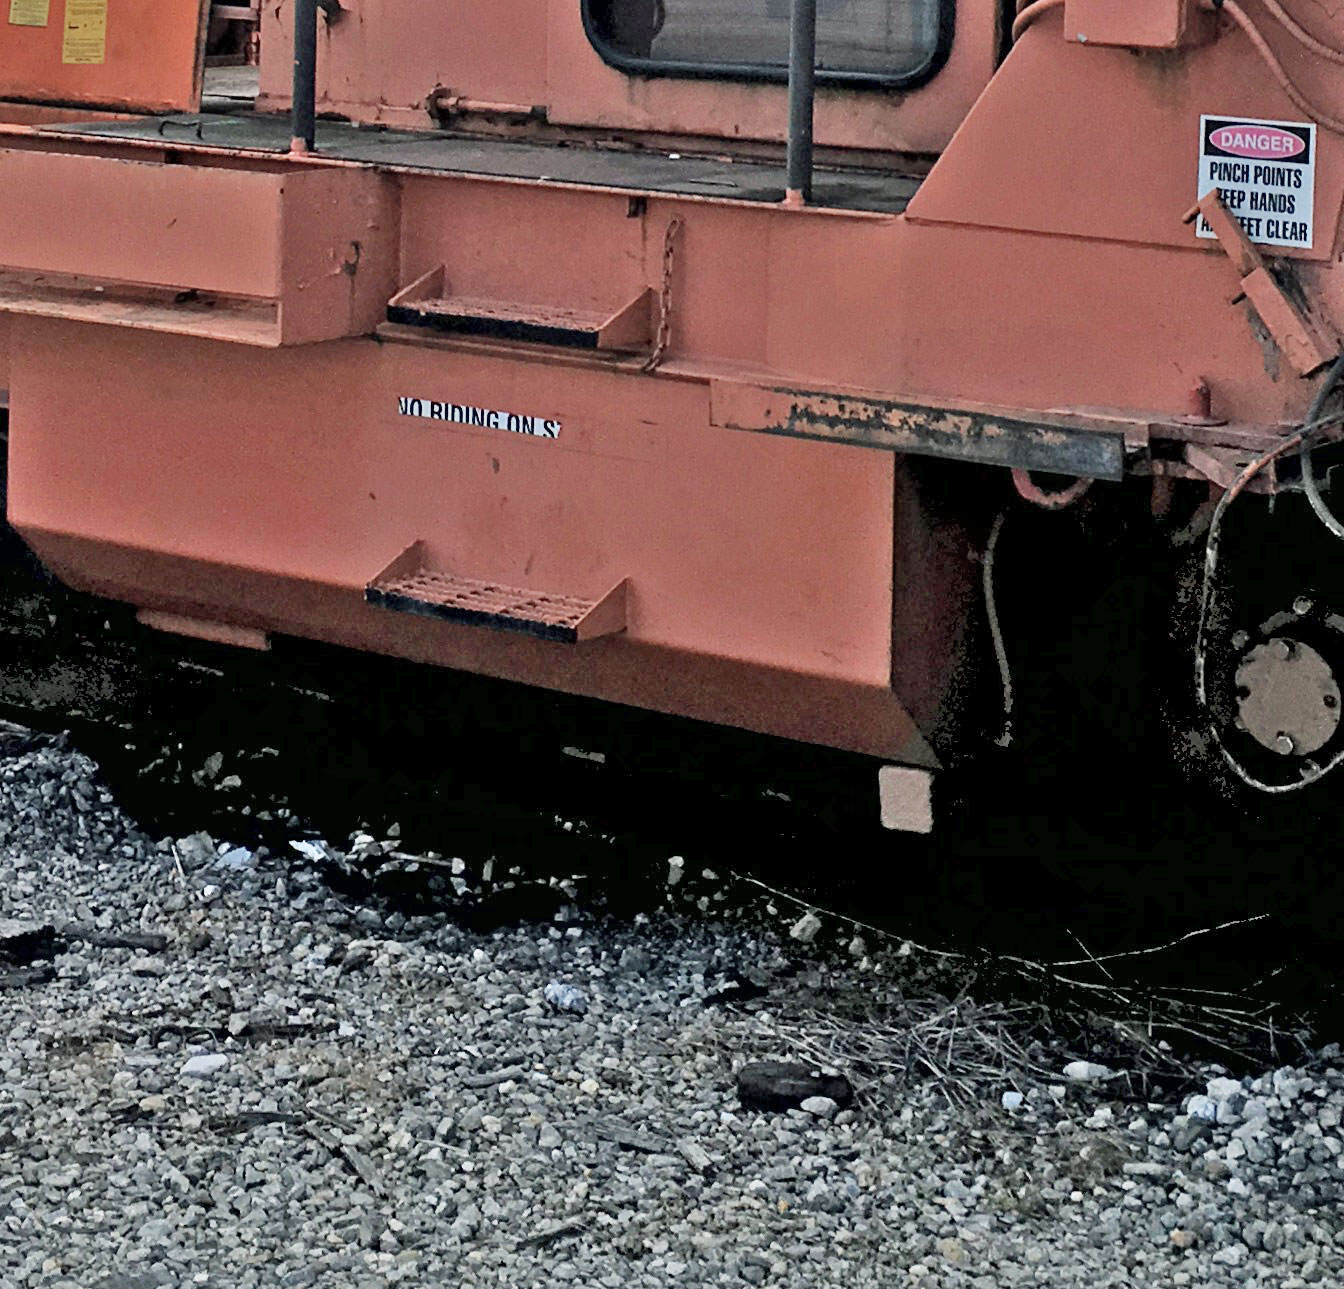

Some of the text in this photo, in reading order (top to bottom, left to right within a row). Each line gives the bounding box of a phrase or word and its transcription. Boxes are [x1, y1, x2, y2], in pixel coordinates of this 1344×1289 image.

[1221, 132, 1294, 153] DANGER
[1209, 161, 1303, 189] PINCH POINTS
[1249, 192, 1296, 215] HANDS
[1266, 219, 1308, 242] CLEAR
[430, 401, 499, 429] RIDING
[506, 413, 536, 435] ON
